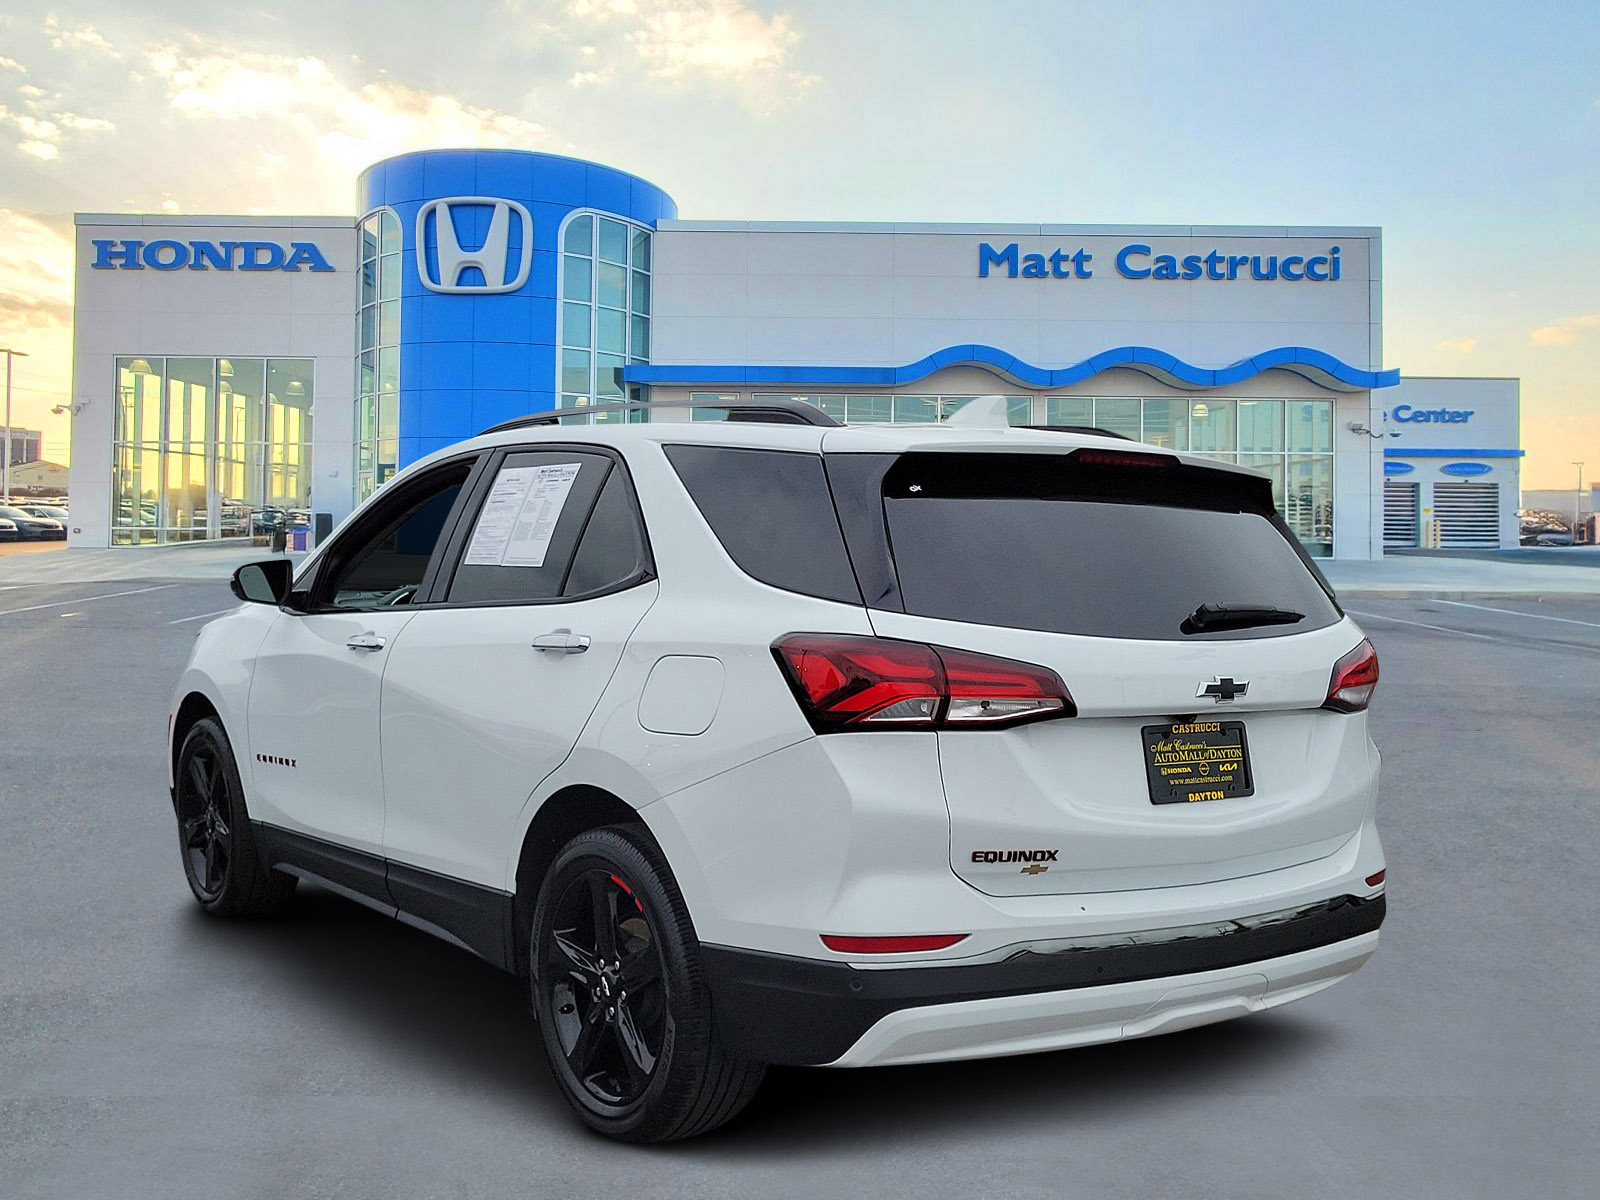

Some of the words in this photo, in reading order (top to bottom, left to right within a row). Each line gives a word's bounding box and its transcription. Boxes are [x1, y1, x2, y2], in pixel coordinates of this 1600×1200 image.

[91, 239, 337, 273] HONDA
[979, 242, 1093, 279] Matt
[1115, 244, 1342, 281] Castrucci
[1391, 404, 1475, 424] Center
[1172, 722, 1221, 734] CASTRUCCI
[1167, 766, 1193, 774] HONDA
[1188, 790, 1225, 803] DAYTON
[971, 849, 1060, 864] EQUINOX
